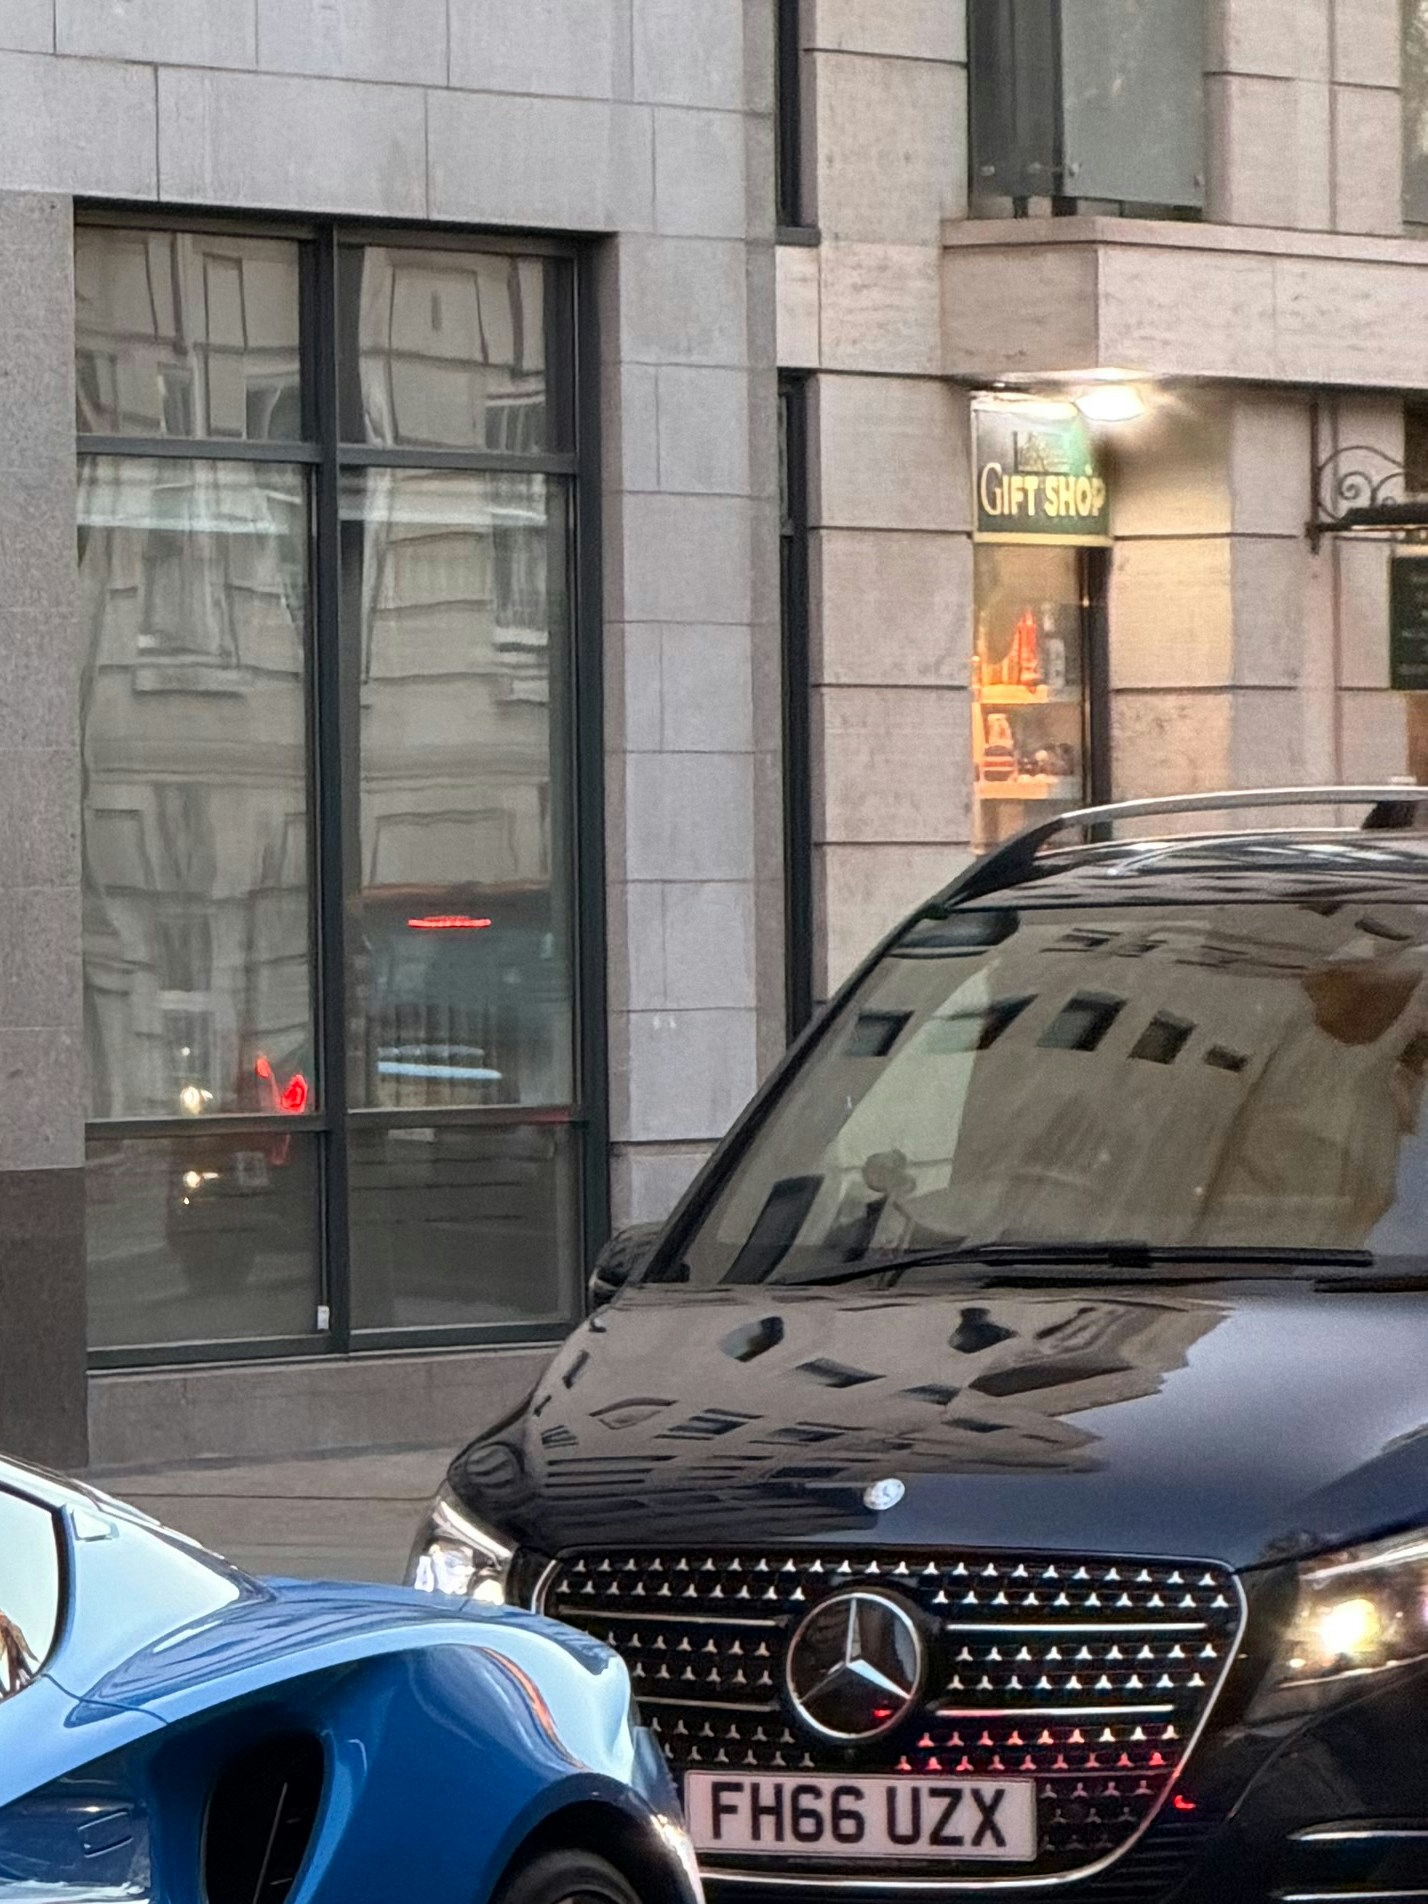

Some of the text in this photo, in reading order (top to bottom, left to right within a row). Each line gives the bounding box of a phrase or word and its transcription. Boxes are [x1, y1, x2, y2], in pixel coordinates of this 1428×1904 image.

[980, 462, 1106, 517] GIFT SHOP
[710, 1781, 1008, 1849] FH66 UZX
